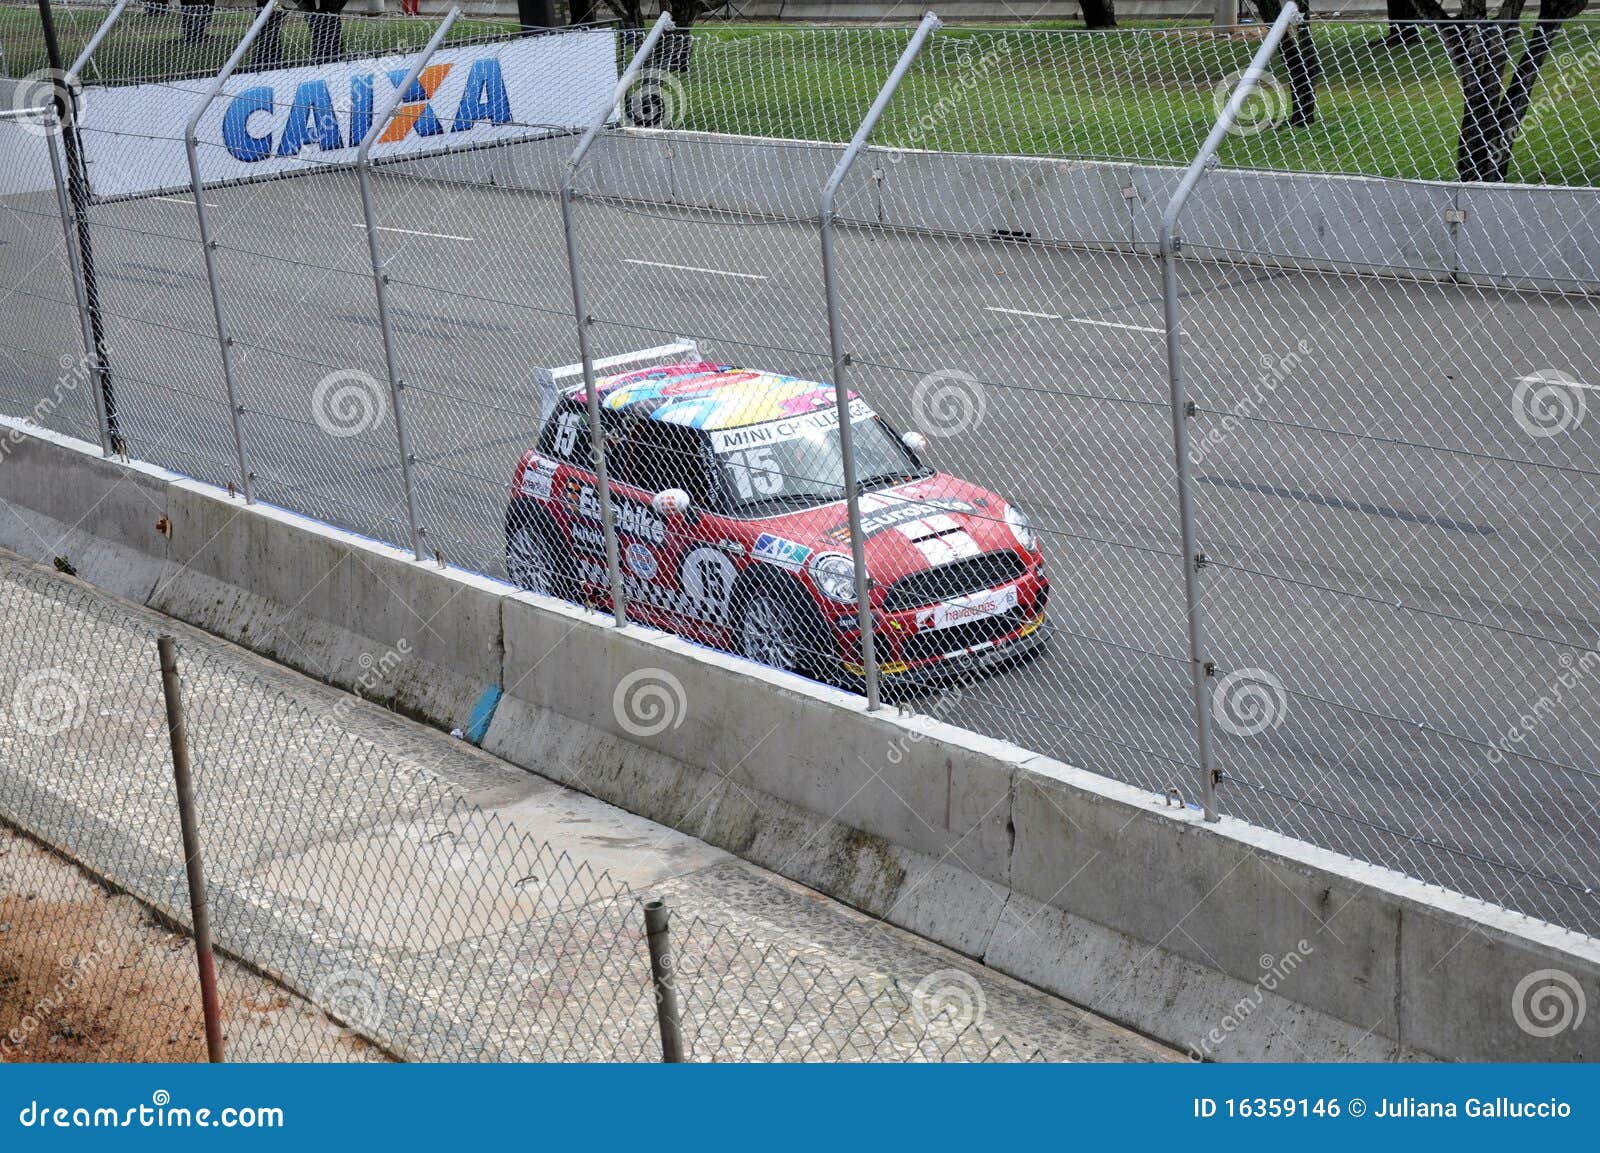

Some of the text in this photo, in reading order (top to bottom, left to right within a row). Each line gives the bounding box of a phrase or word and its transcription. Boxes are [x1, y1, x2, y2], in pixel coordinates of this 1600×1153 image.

[222, 57, 513, 163] CAIXA
[554, 411, 581, 456] 15
[723, 427, 772, 447] MINI
[725, 447, 785, 500] 15
[695, 559, 725, 602] 15
